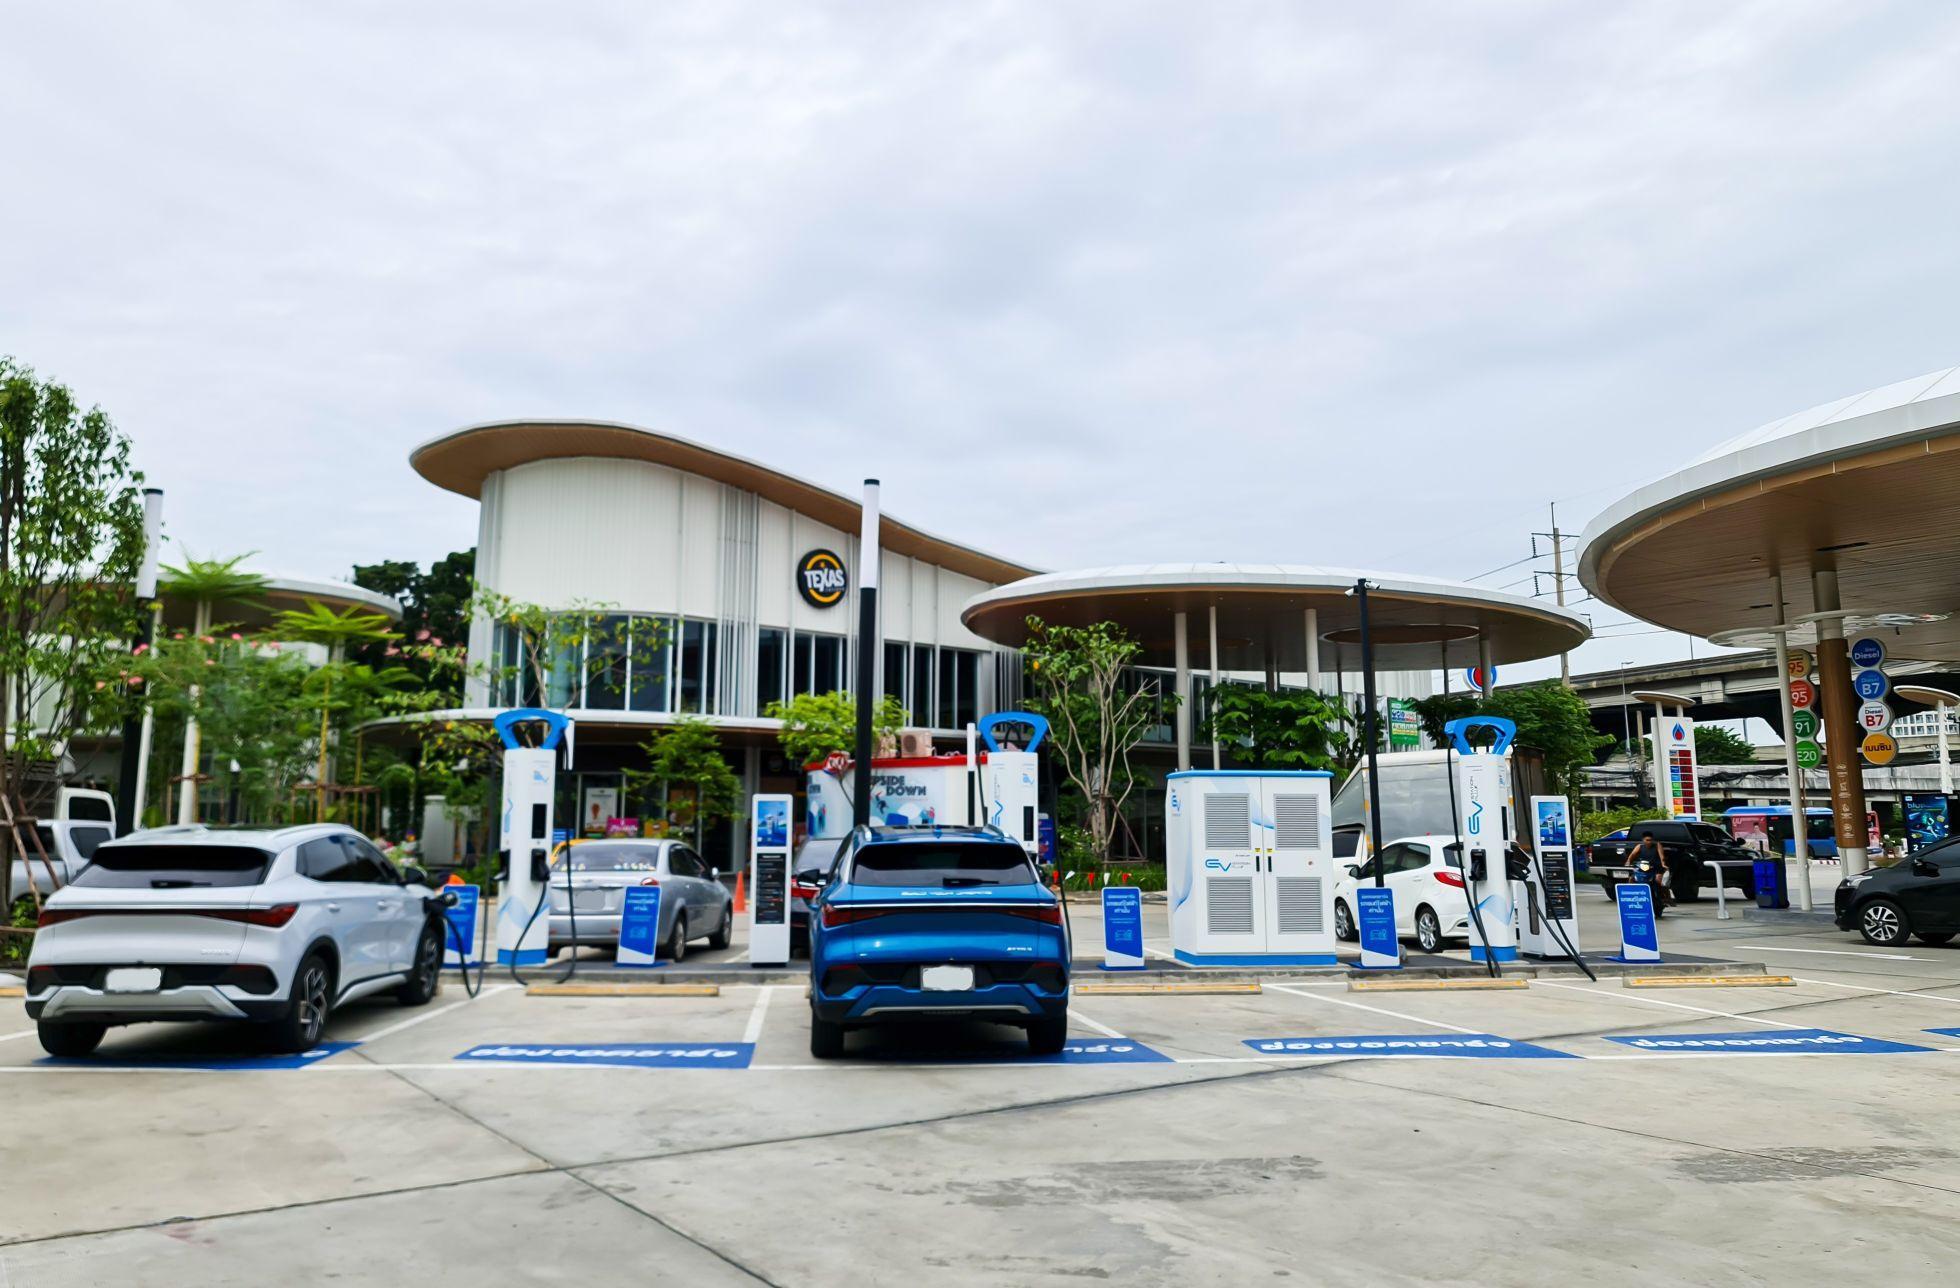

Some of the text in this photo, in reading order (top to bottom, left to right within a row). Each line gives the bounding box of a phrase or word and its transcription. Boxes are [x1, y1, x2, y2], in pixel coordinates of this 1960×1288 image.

[804, 568, 845, 592] TEXAS
[1854, 651, 1880, 660] Diesel
[1862, 683, 1880, 695] B7
[1791, 691, 1808, 703] 95
[1866, 715, 1884, 726] B7
[1795, 722, 1811, 734] 91
[871, 775, 905, 786] PSIDE
[886, 785, 926, 796] DOWN
[1468, 800, 1483, 835] EV
[1205, 858, 1231, 872] EV
